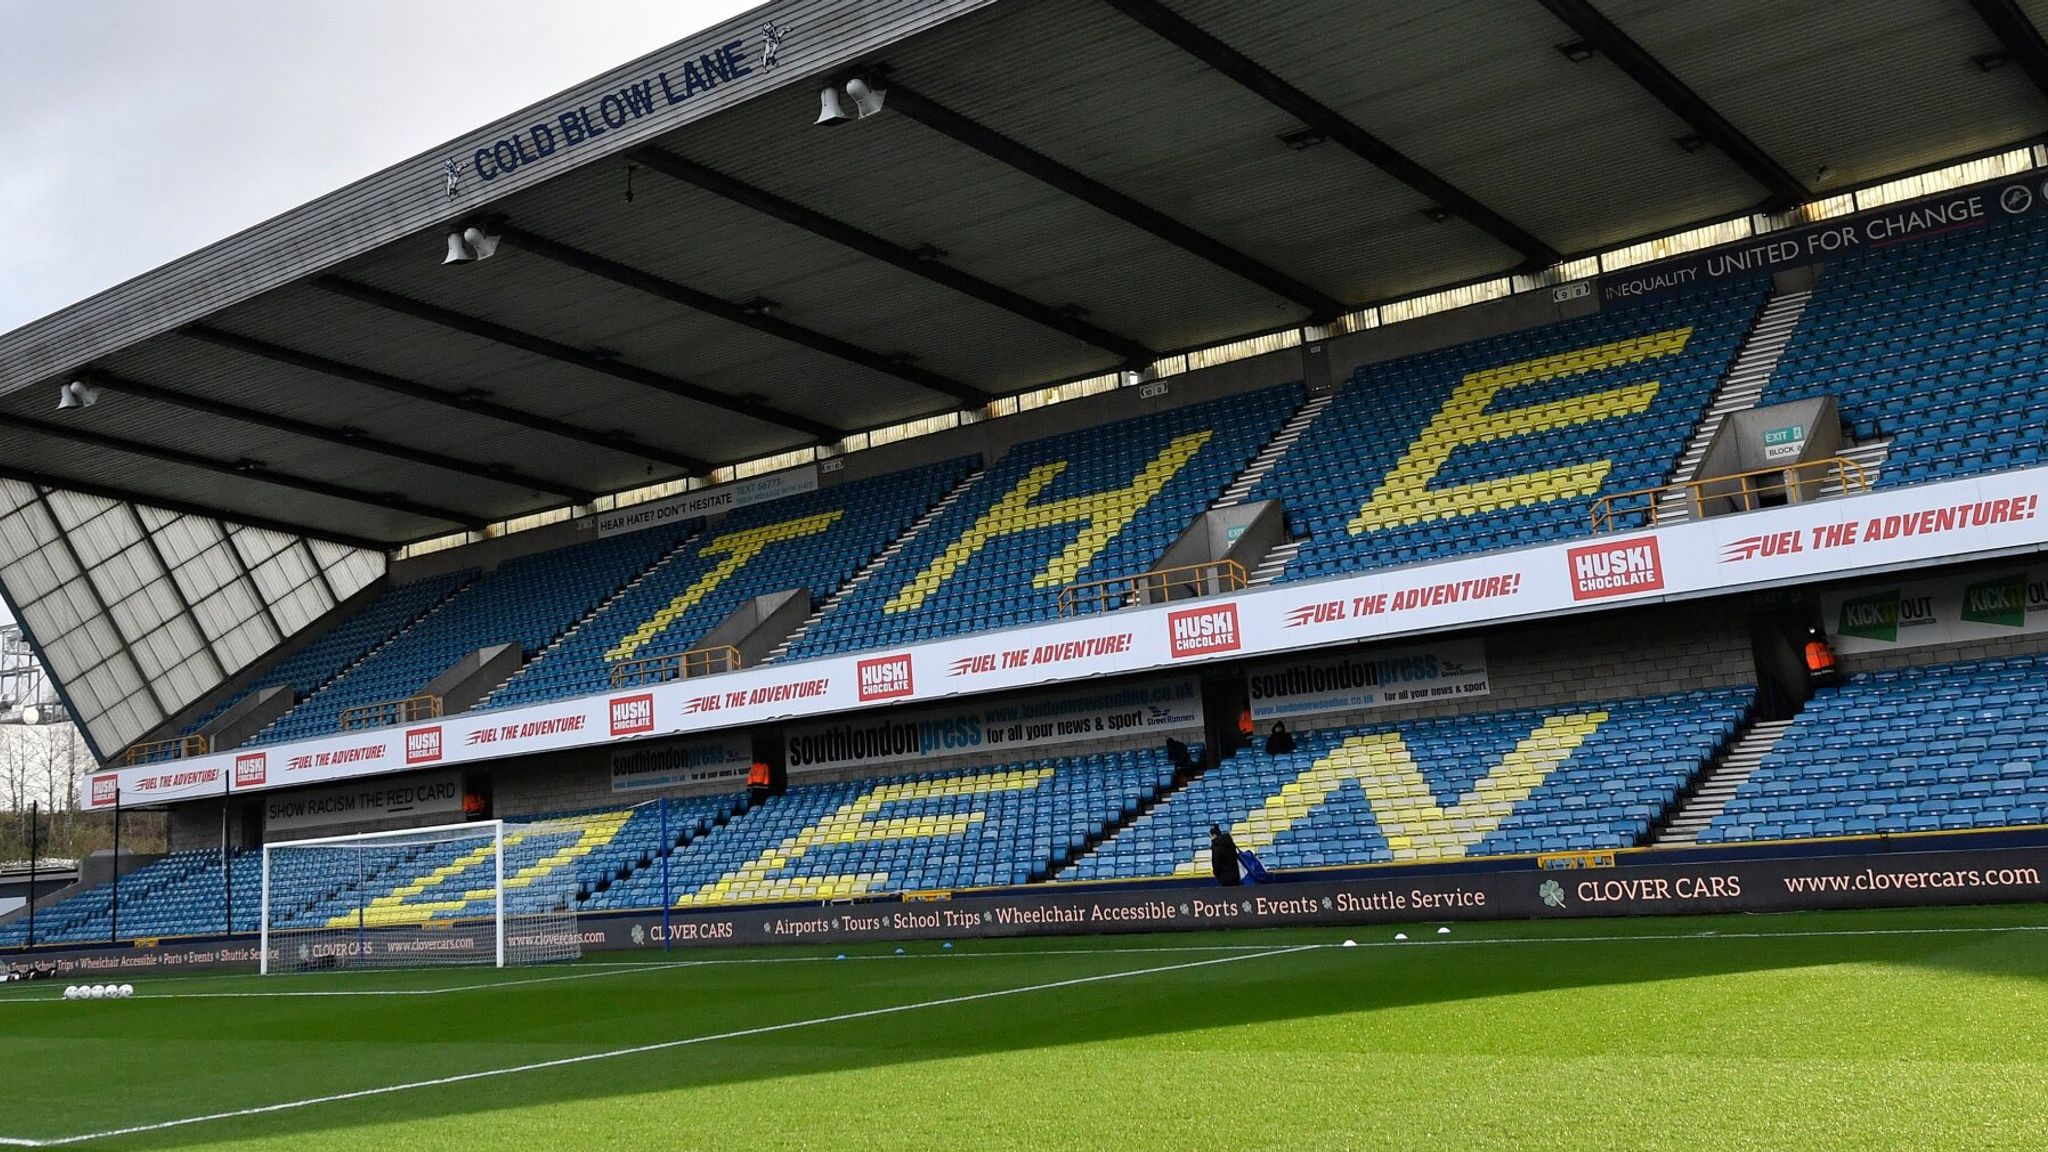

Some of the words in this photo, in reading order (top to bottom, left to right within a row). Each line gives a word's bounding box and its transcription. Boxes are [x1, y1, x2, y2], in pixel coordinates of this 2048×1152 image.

[473, 122, 556, 181] COLD
[558, 79, 654, 147] BLOW
[659, 40, 752, 106] LANE
[1605, 267, 1697, 300] INEQUALITY
[1707, 240, 1799, 276] UNITED
[1807, 227, 1860, 255] FOR
[1866, 196, 1985, 240] CHANGE
[1765, 431, 1787, 442] EXIT
[1769, 445, 1794, 456] BLOCK
[600, 517, 625, 532] HEAR
[626, 511, 655, 528] HATE?
[657, 504, 687, 521] DON'T
[689, 492, 732, 512] HESITATE
[1717, 530, 1803, 564] FUEL
[1812, 521, 1858, 550] THE
[1863, 495, 2038, 540] ADVENTURE!
[1575, 548, 1653, 579] HUSKI
[1578, 570, 1655, 592] CHOCOLATE
[1280, 600, 1346, 629] FUEL
[1352, 592, 1388, 617] THE
[1390, 573, 1521, 612] ADVENTURE!
[1845, 602, 1883, 626] KICK
[1901, 596, 1932, 619] OUT
[1969, 587, 2009, 612] KICK
[1174, 611, 1233, 640] HUSKI
[1176, 632, 1234, 651] CHOCOLATE
[946, 654, 997, 678] FUEL
[1001, 648, 1029, 670] THE
[1031, 633, 1133, 664] ADVENTURE!
[861, 660, 908, 685] HUSKI
[681, 697, 721, 715] FUEL
[725, 691, 747, 710] THE
[749, 678, 830, 707] ADVENTURE!
[862, 679, 909, 696] CHOCOLATE
[1384, 690, 1397, 702] for
[1398, 689, 1408, 700] all
[1410, 688, 1429, 700] your
[1431, 686, 1454, 697] news
[1464, 681, 1486, 695] sport
[612, 700, 650, 720] HUSKI
[465, 729, 498, 746] FUEL
[500, 724, 517, 740] THE
[519, 715, 586, 738] ADVENTURE!
[613, 716, 650, 731] CHOCOLATE
[986, 726, 1004, 744] for
[1008, 722, 1023, 741] all
[1026, 723, 1054, 742] your
[1057, 718, 1091, 736] news
[1095, 716, 1104, 730] &
[1108, 710, 1143, 731] sport
[408, 730, 440, 750] HUSKI
[790, 714, 982, 767] southlondonpress
[285, 754, 313, 771] FUEL
[314, 750, 330, 767] THE
[331, 744, 386, 765] ADVENTURE!
[408, 747, 440, 759] CHOCOLATE
[238, 758, 263, 775] HUSKI
[135, 778, 159, 792] FUEL
[160, 776, 172, 790] THE
[173, 768, 220, 787] ADVENTURE!
[269, 801, 305, 820] SHOW
[308, 796, 354, 815] RACISM
[358, 793, 384, 809] THE
[387, 788, 414, 805] RED
[417, 782, 456, 800] CARD
[1576, 880, 1671, 903] CLOVER
[1674, 875, 1742, 898] CARS
[1783, 865, 2041, 894] www.clovercars.com
[774, 918, 830, 937] Airports
[842, 915, 880, 932] Tours
[894, 911, 940, 929] School
[944, 910, 981, 928] Trips
[996, 905, 1086, 925] Wheelchair
[1091, 902, 1176, 922] Accessible
[1193, 900, 1238, 918] Ports
[1256, 896, 1318, 916] Events
[1336, 891, 1406, 912] Shuttle
[1410, 888, 1486, 909] Service
[507, 930, 606, 946] www.clovercars.com
[700, 922, 733, 939] CARS
[312, 943, 347, 958] CLOVER
[388, 937, 474, 952] www.clovercars.com
[58, 959, 74, 972] Trips
[80, 956, 120, 969] Wheelchair
[120, 953, 157, 967] Accessible
[164, 952, 182, 965] Ports
[188, 951, 214, 964] Events
[220, 949, 248, 962] Shuttle
